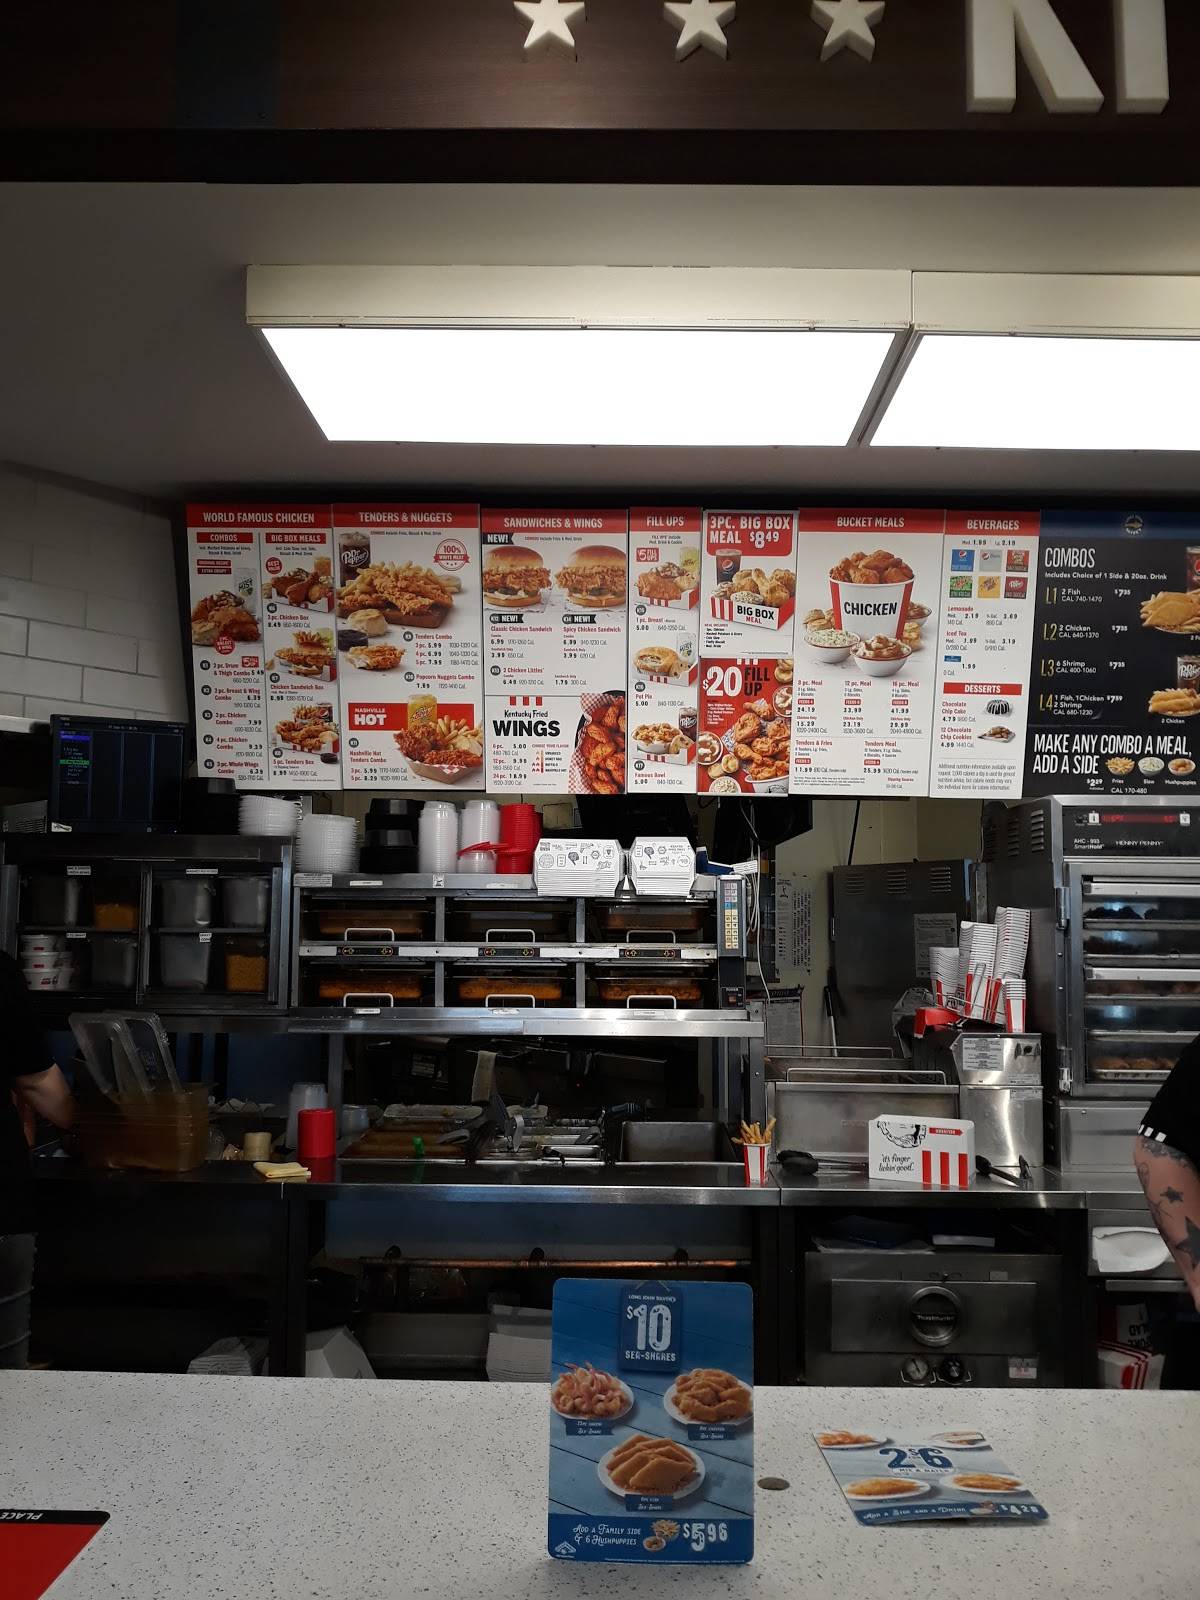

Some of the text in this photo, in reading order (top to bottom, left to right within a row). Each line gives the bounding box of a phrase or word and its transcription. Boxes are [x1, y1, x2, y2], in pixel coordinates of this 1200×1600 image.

[203, 512, 315, 523] WORLD FAMOUS CHICKEN
[359, 512, 452, 522] TENDERS & NUGGETS
[646, 516, 684, 526] FILL UPS
[710, 516, 790, 529] 3PC. BIG BOX
[837, 517, 904, 528] BUCKET MEALS
[504, 518, 603, 528] SANDWICHES & WINGS
[967, 520, 1020, 530] BEVERAGES
[210, 534, 238, 542] COMBOS
[271, 534, 321, 543] BIG BOX MEALS
[487, 534, 509, 543] NEW!
[710, 531, 741, 543] MEAL
[443, 545, 461, 553] 100%
[1045, 547, 1096, 568] COMBOS
[1045, 587, 1058, 605] L1
[737, 605, 775, 620] BIG BOX
[844, 601, 897, 616] CHICKEN
[745, 616, 762, 625] MEAL
[1043, 623, 1057, 641] L2
[1041, 659, 1055, 677] L3
[702, 666, 770, 697] $20 FILL
[744, 682, 762, 696] UP
[964, 684, 1001, 693] DESSERTS
[1039, 694, 1053, 711] L4
[354, 714, 387, 725] HOT
[504, 710, 532, 718] Kentucky
[492, 720, 561, 737] WINGS
[1034, 734, 1192, 757] MAKE ANY COMBO A MEAL,
[1033, 754, 1100, 774] ADD A SIDE
[892, 1153, 911, 1165] finger
[626, 1304, 672, 1352] $10
[625, 1350, 676, 1362] SEA-SHARES
[0, 1512, 44, 1520] PLACE
[572, 1524, 589, 1534] ADD
[599, 1524, 625, 1535] FAMILY
[627, 1527, 641, 1535] SIDE
[592, 1535, 637, 1546] HUSHPUPPIES
